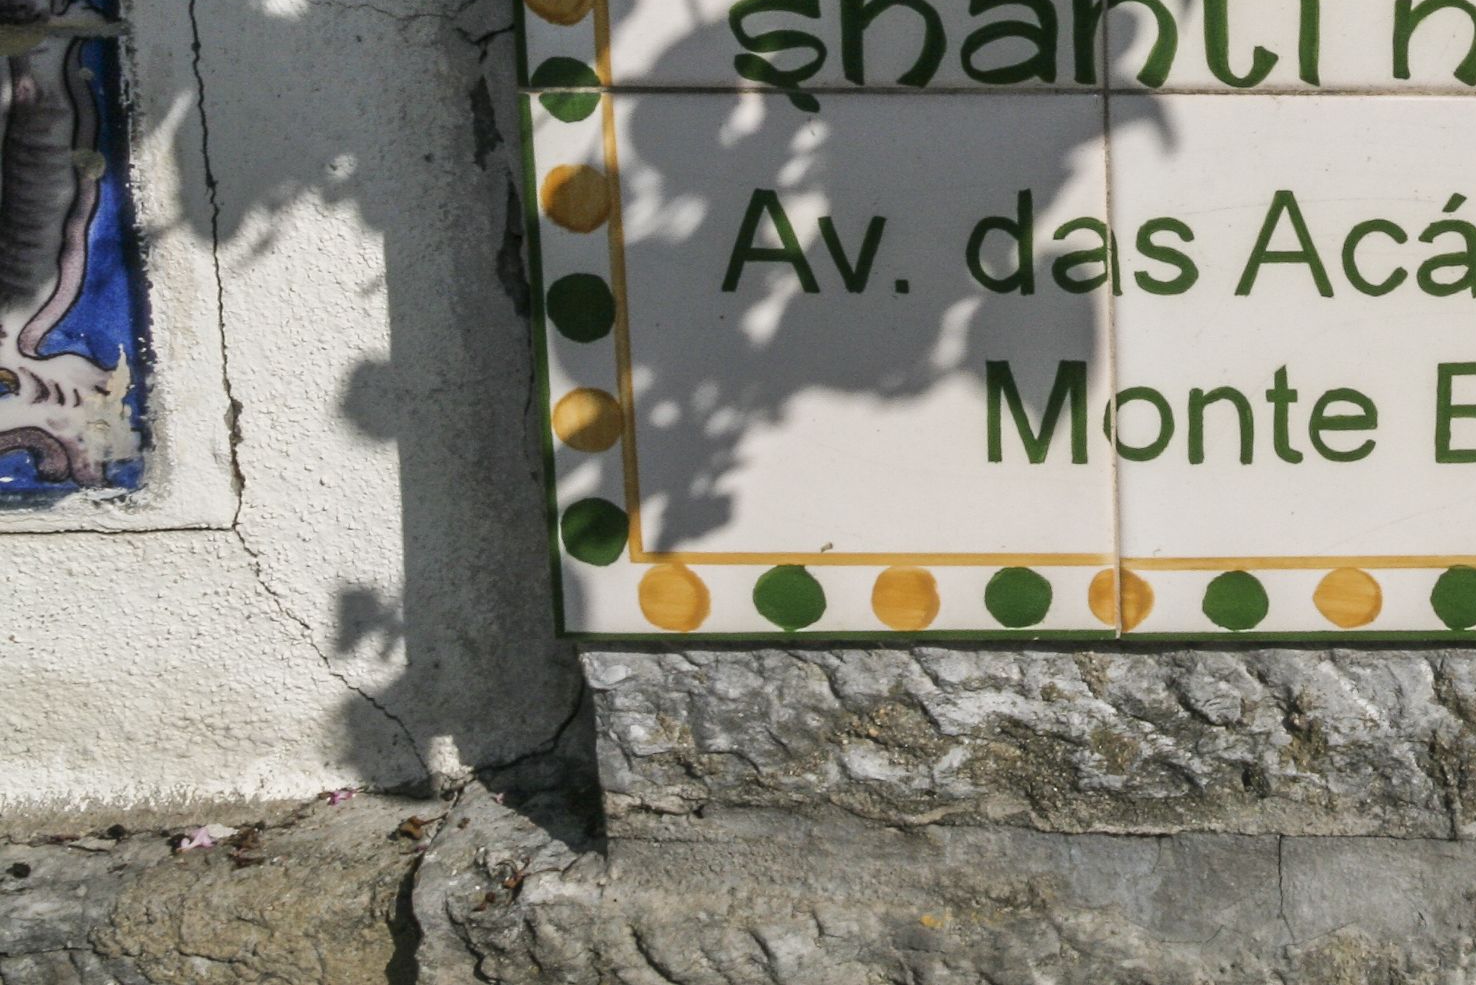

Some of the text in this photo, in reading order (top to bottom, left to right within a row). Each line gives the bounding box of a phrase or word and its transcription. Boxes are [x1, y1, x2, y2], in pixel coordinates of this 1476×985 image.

[722, 187, 908, 297] Av.
[966, 188, 1201, 297] das
[985, 361, 1379, 466] Monte
